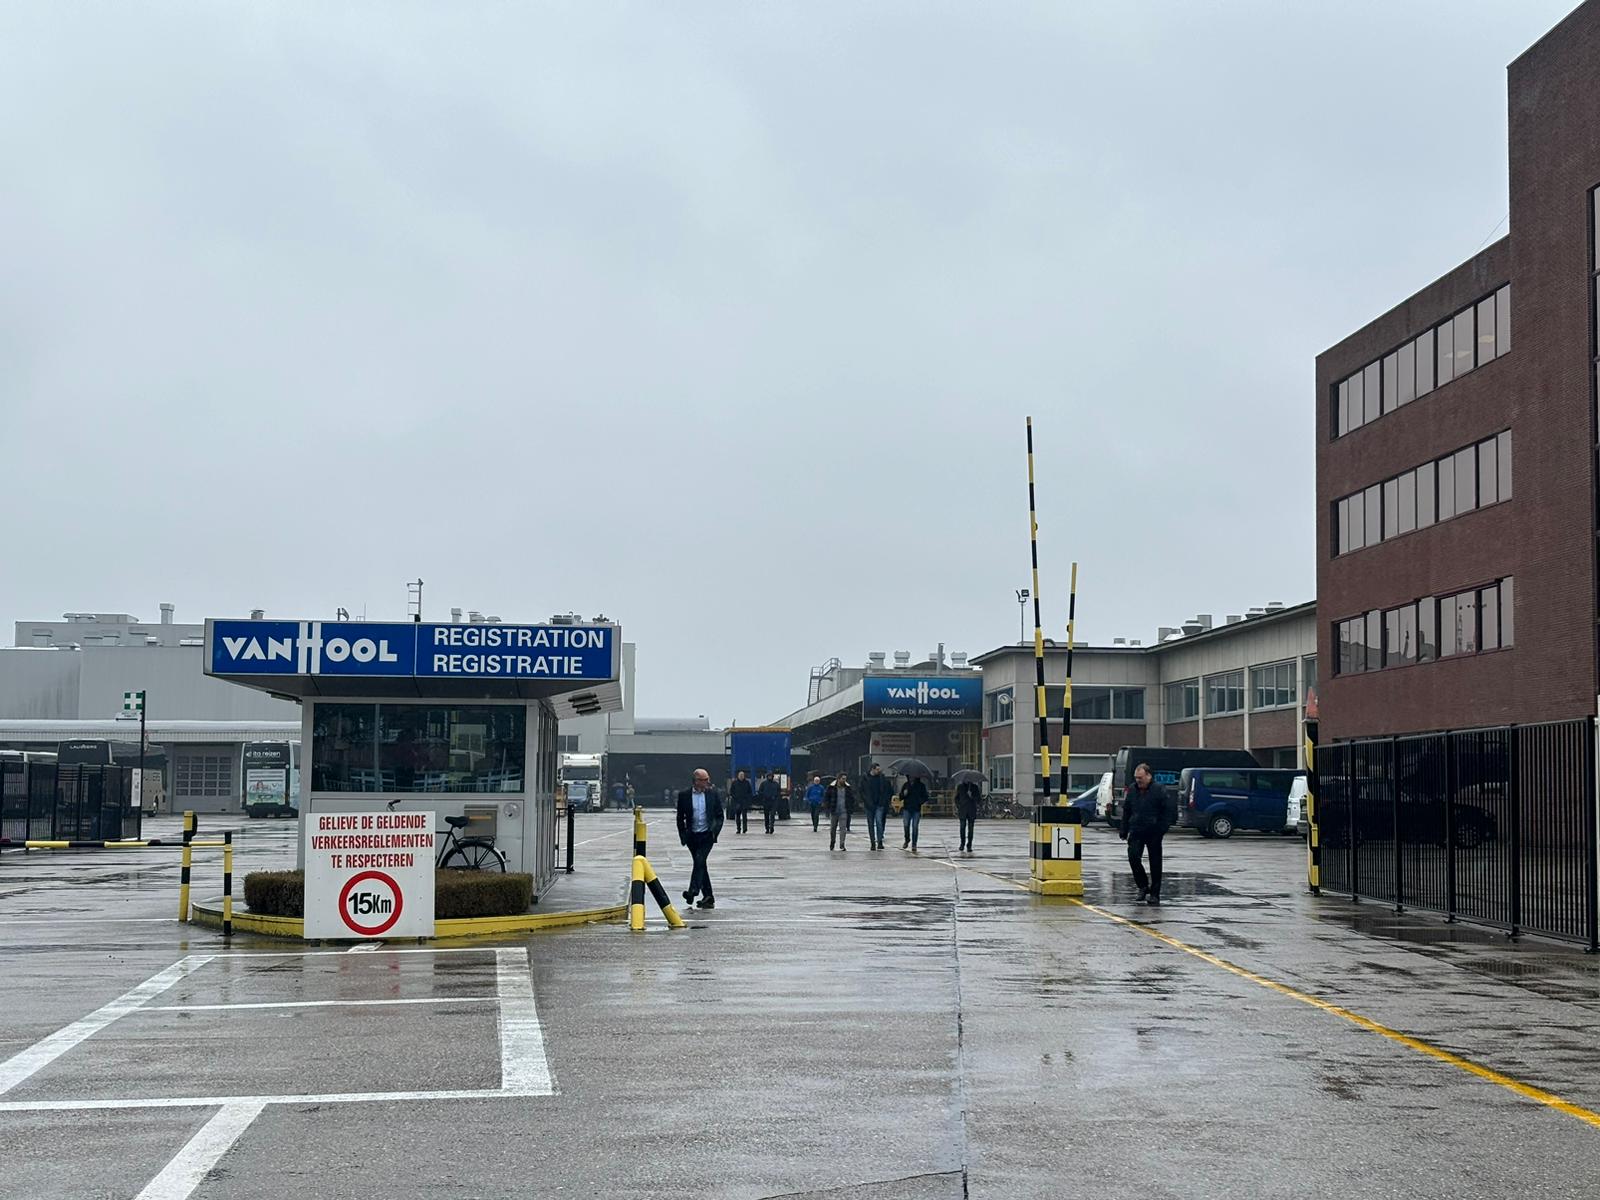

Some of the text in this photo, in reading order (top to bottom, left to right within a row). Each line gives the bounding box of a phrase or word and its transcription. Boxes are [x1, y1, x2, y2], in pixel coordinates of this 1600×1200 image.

[433, 627, 604, 649] REGISTRATION
[433, 654, 583, 675] REGISTRATIE
[881, 707, 908, 716] Welkom
[319, 815, 426, 831] GELIEVE DE GELDENDE
[311, 834, 433, 849] VERKEERSREGLEMENTEN
[331, 853, 414, 869] TE RESPECTEREN
